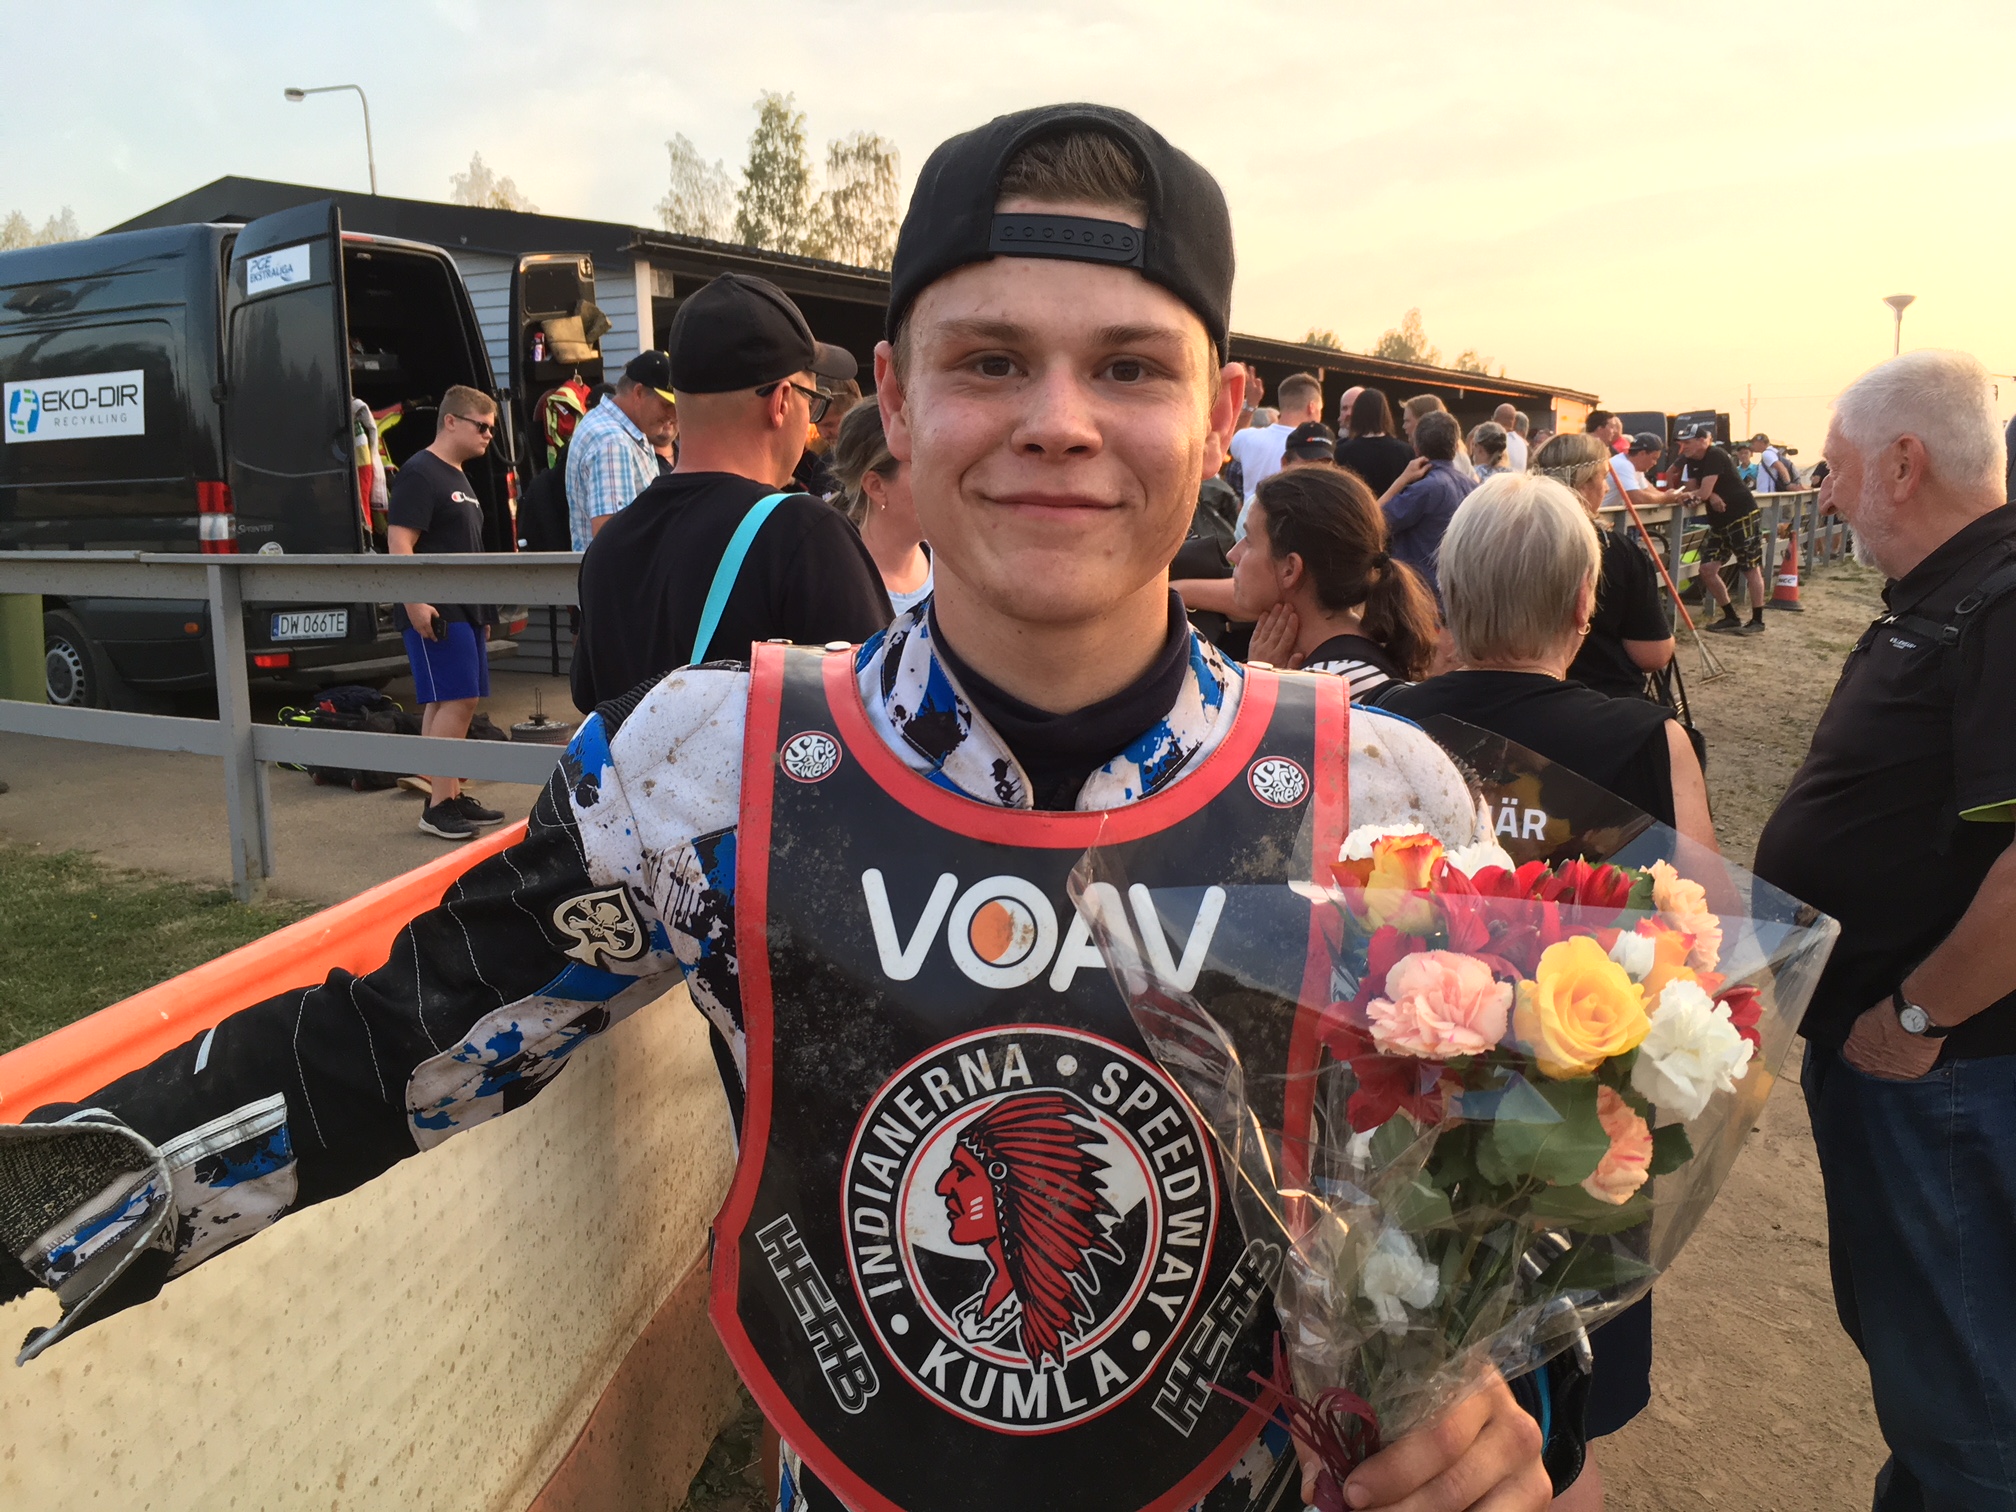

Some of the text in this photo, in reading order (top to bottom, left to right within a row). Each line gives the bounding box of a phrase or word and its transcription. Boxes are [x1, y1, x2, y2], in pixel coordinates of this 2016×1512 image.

[250, 264, 293, 283] EKSTRALIGA
[42, 384, 138, 412] EKO-DIR
[54, 413, 128, 427] RECYKLING
[281, 613, 345, 634] DW 066TE
[1488, 797, 1547, 841] ÄR
[861, 868, 1226, 994] VOAV
[854, 1043, 1034, 1299] INDIANERNA
[1092, 1061, 1205, 1323] SPEEDWAY
[918, 1338, 1129, 1419] KUMLA
